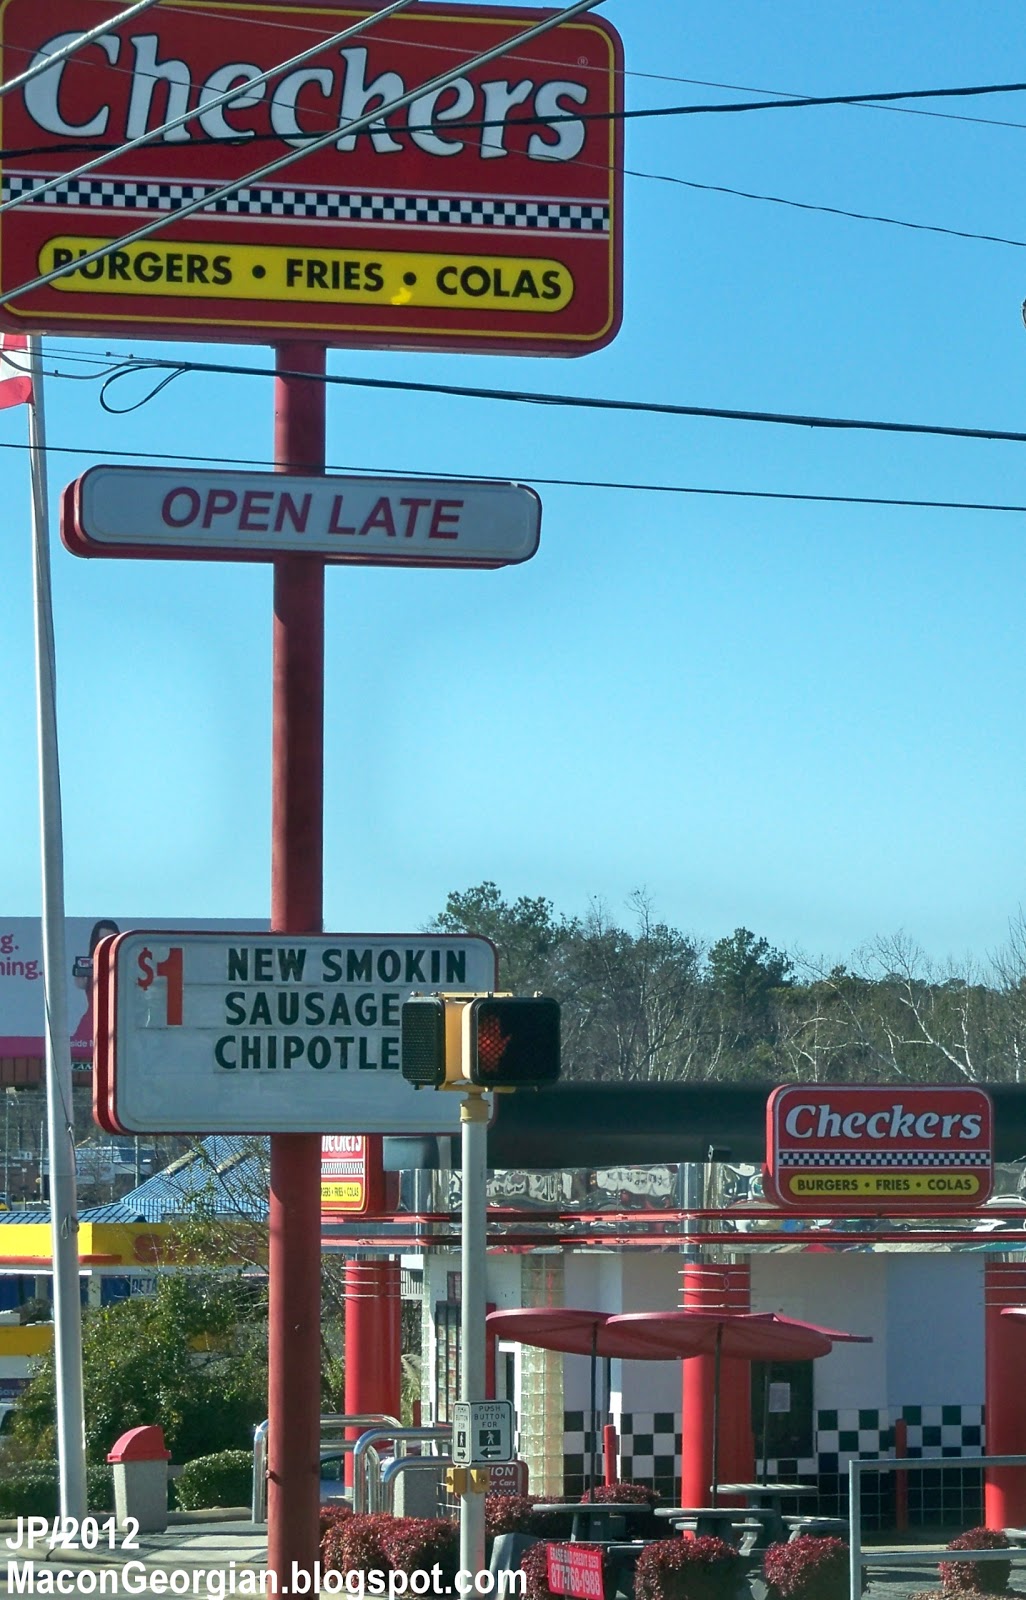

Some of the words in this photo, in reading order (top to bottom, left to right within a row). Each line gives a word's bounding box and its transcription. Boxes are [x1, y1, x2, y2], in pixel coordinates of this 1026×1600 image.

[23, 31, 588, 162] Checkers
[52, 247, 233, 285] BURGERS
[286, 259, 385, 291] FRIES
[436, 265, 562, 300] COLAS
[161, 486, 313, 534] OPEN
[328, 494, 464, 541] LATE
[227, 947, 307, 983] NEW
[322, 948, 467, 984] SMOKIN
[137, 946, 184, 1026] $1
[225, 991, 401, 1027] SAUSAGE
[214, 1035, 400, 1070] CHIPOTLE
[785, 1104, 982, 1140] Checkers
[797, 1179, 859, 1191] BURGERS
[876, 1179, 910, 1191] FRIES
[927, 1179, 972, 1191] COLAS
